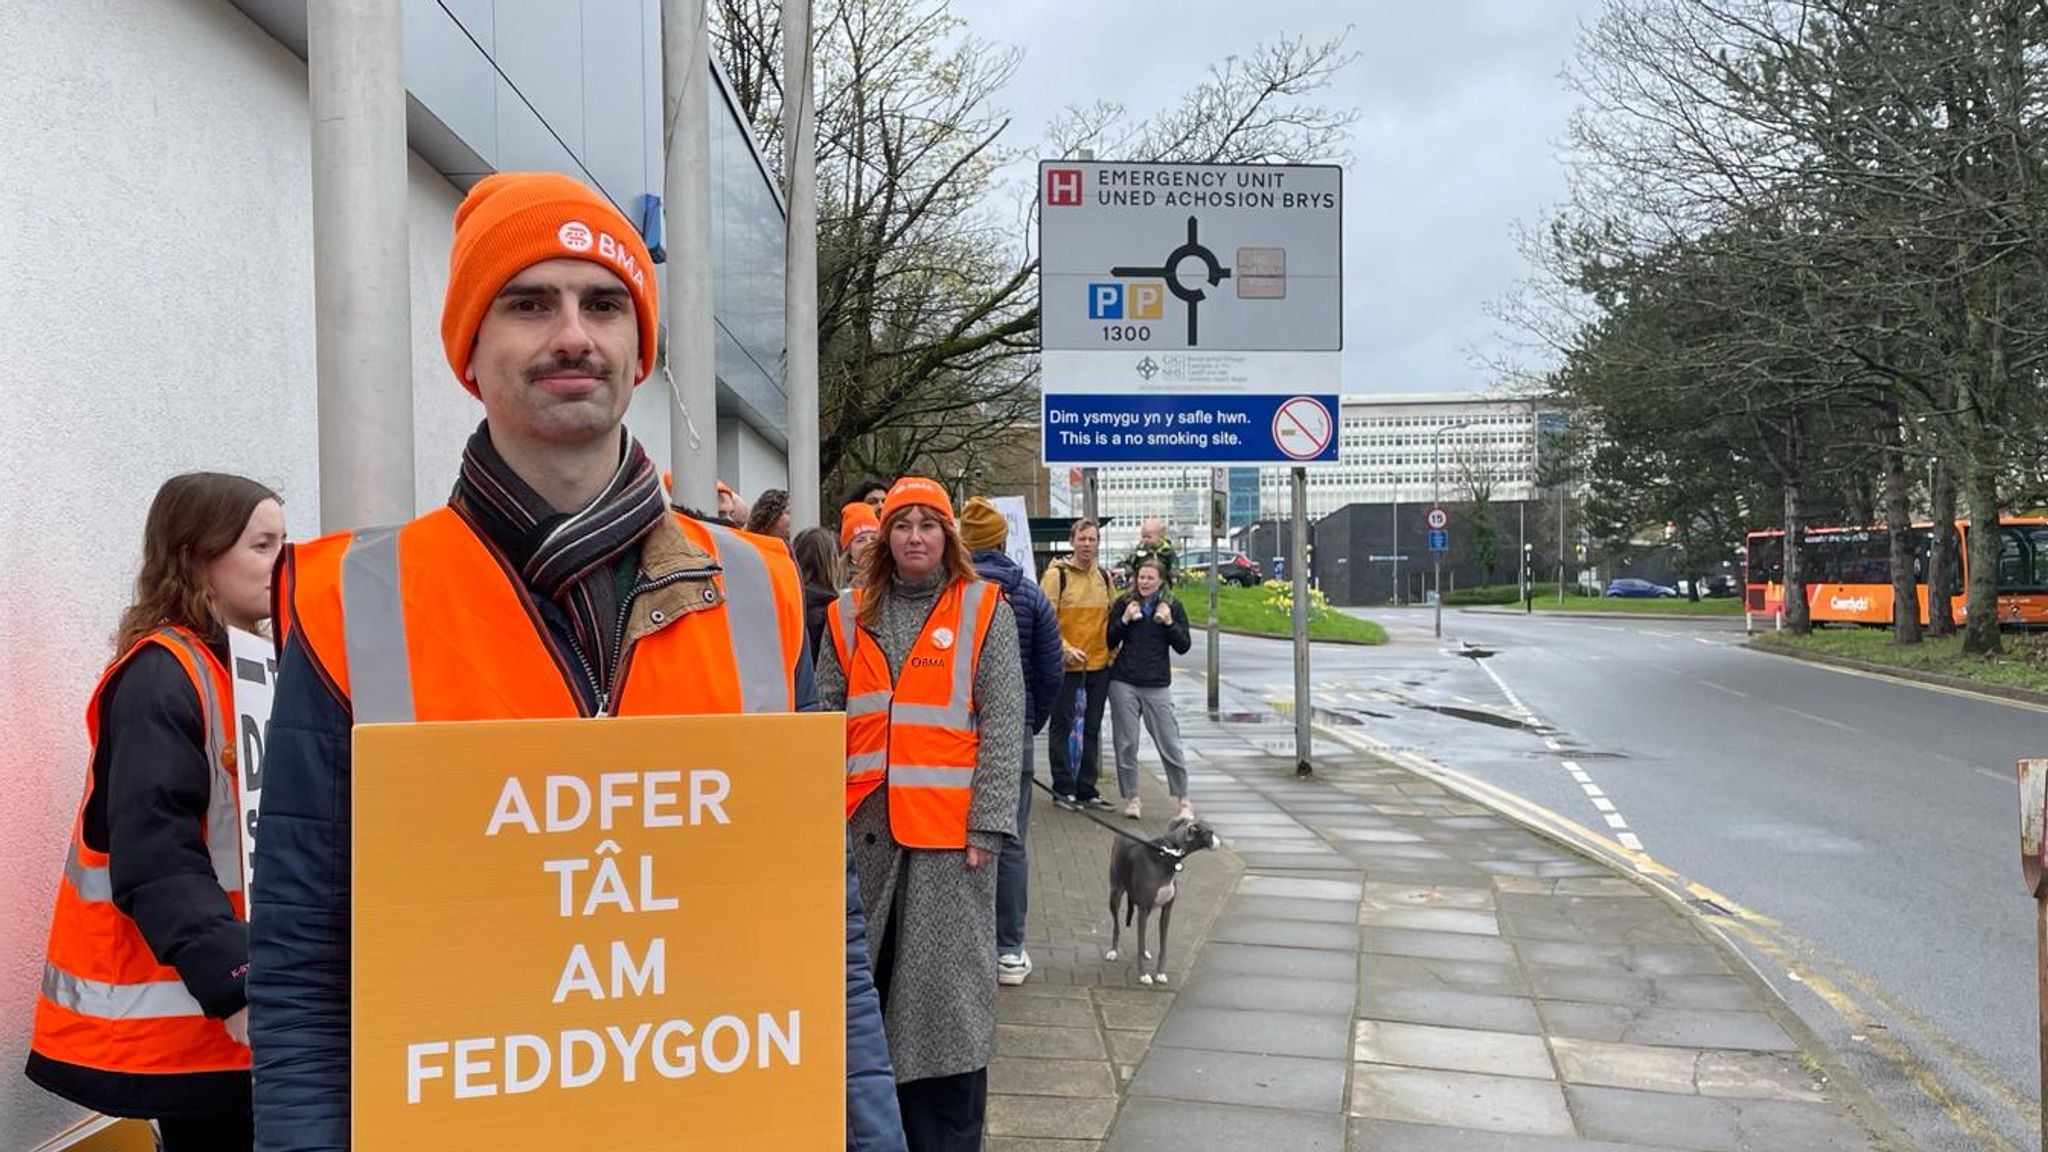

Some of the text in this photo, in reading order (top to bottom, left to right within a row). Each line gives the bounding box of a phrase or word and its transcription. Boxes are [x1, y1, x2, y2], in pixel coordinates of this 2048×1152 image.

[1053, 173, 1077, 203] H
[1098, 169, 1285, 188] EMERGENCY UNIT
[1098, 190, 1335, 209] UNED ACHOSION BRYS
[599, 231, 645, 297] BMA
[1097, 287, 1157, 317] P P
[1103, 326, 1151, 341] 1300
[1049, 409, 1251, 427] Dim ysmygu yn y safle hwn.
[1059, 430, 1242, 448] This is a no smoking site.
[1431, 513, 1444, 525] 15
[922, 658, 945, 668] BMA
[485, 769, 731, 837] ADFER
[544, 839, 679, 917] TÂL
[552, 937, 666, 1003] AM
[406, 1009, 801, 1105] FEDDYGON
